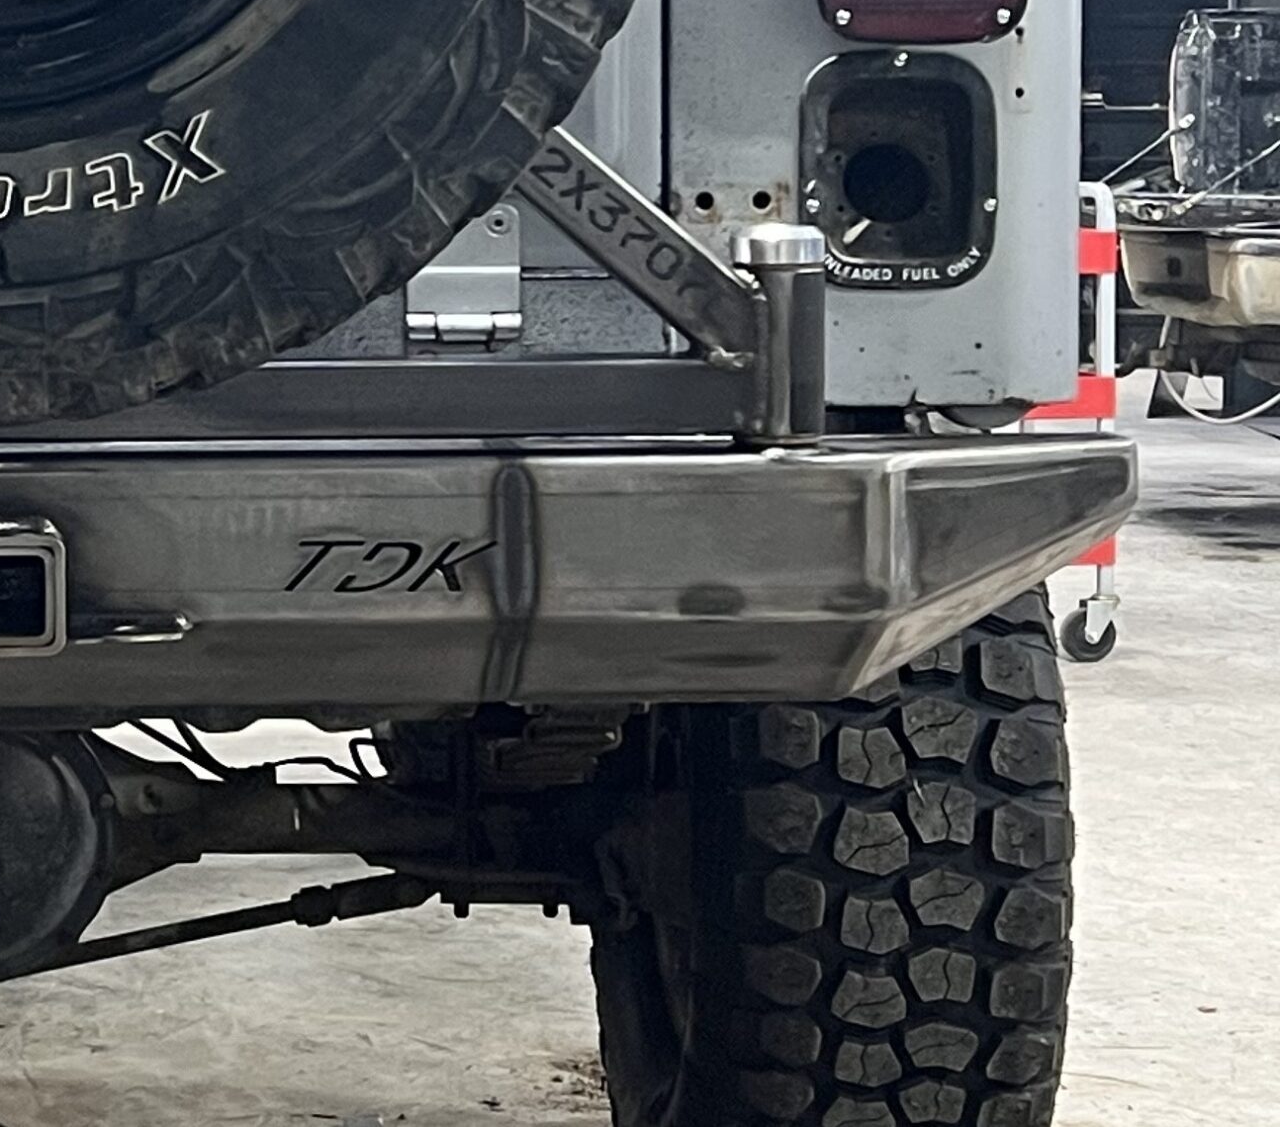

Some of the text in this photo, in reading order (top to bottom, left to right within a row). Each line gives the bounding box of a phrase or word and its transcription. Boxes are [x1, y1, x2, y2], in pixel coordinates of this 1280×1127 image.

[823, 246, 982, 281] NLEADED FUEL ONLY
[284, 539, 498, 593] TDK
